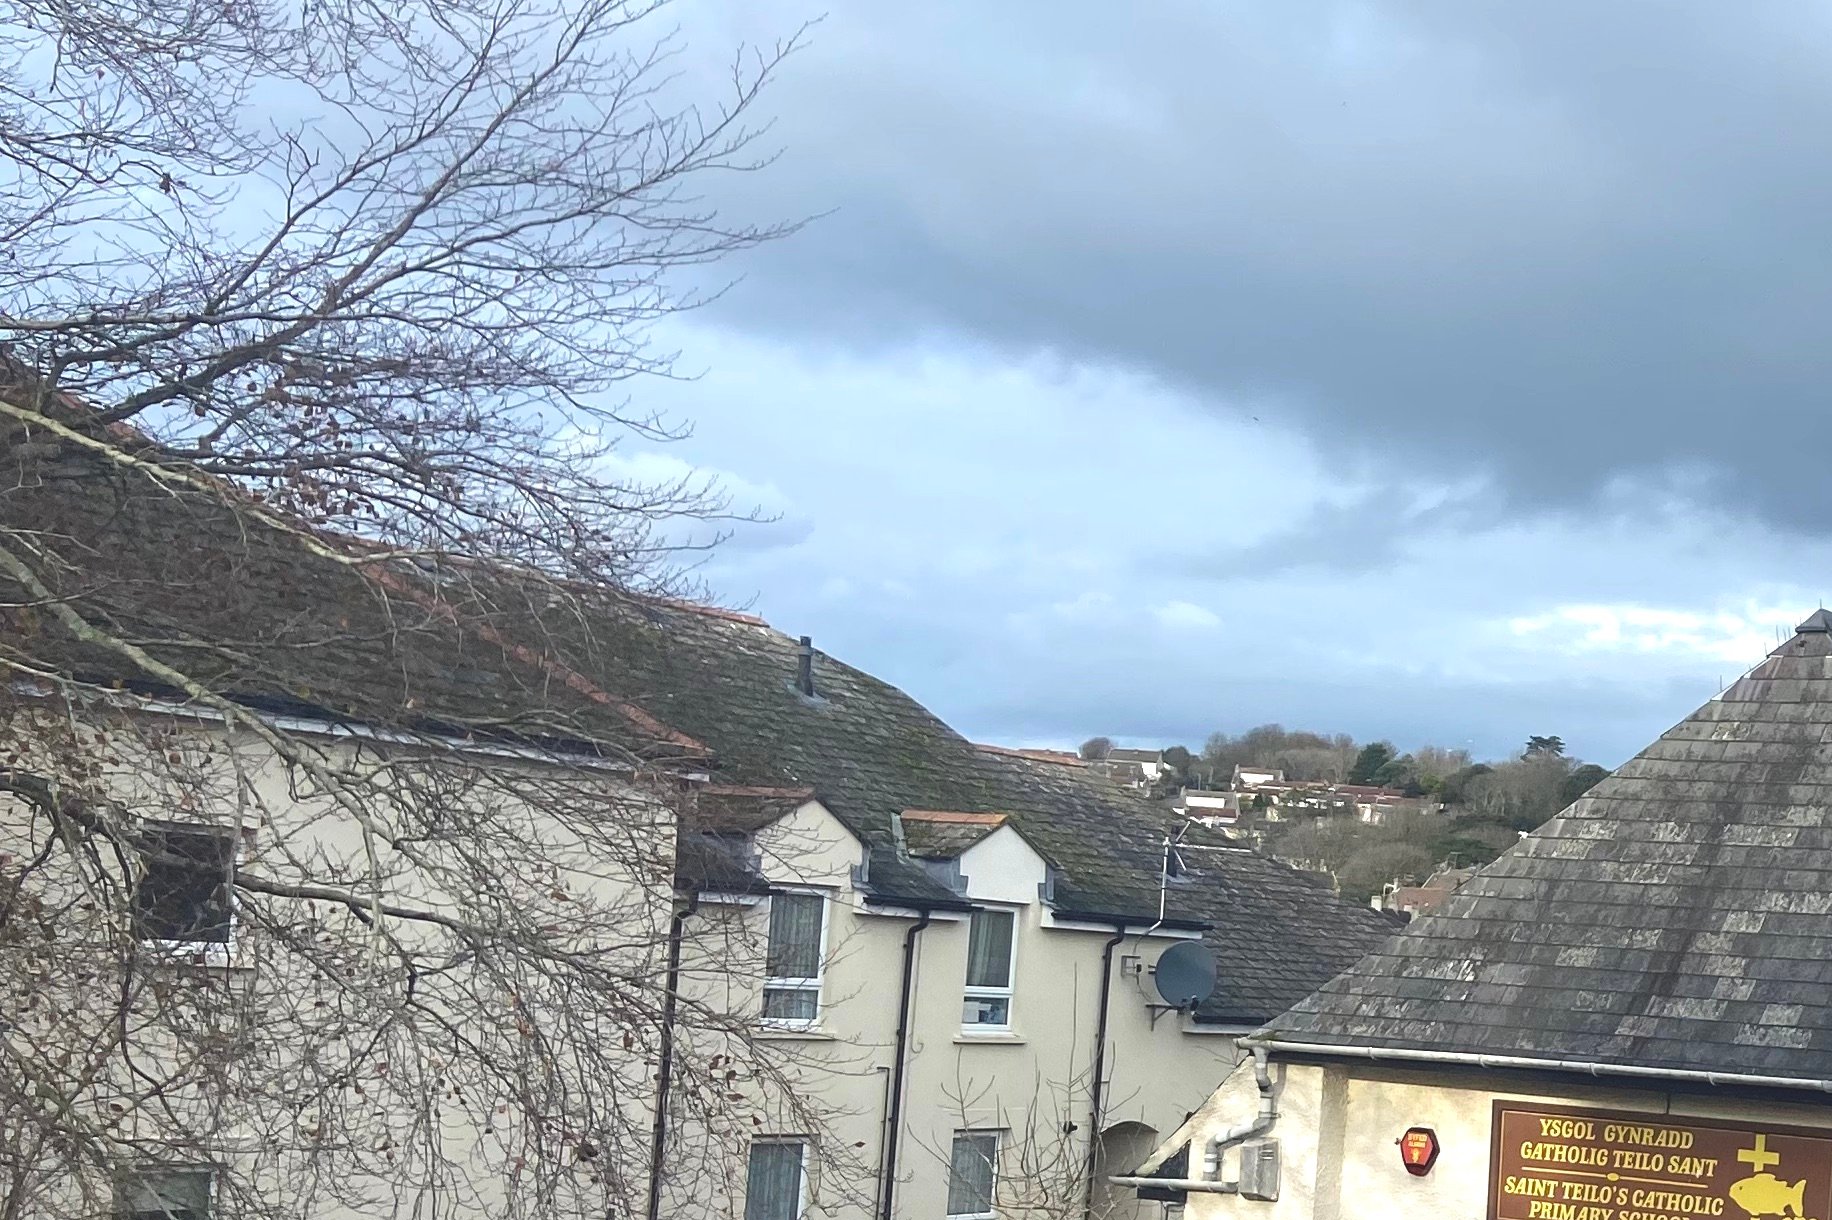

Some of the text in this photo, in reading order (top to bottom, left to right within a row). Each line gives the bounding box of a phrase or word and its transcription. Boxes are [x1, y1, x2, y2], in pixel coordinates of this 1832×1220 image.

[1540, 1118, 1694, 1149] YSGOL GYNRADD
[1520, 1141, 1718, 1178] GATHOLIG TEILO SANT
[1504, 1176, 1724, 1216] SAINT TEILO'S CATHOLIC
